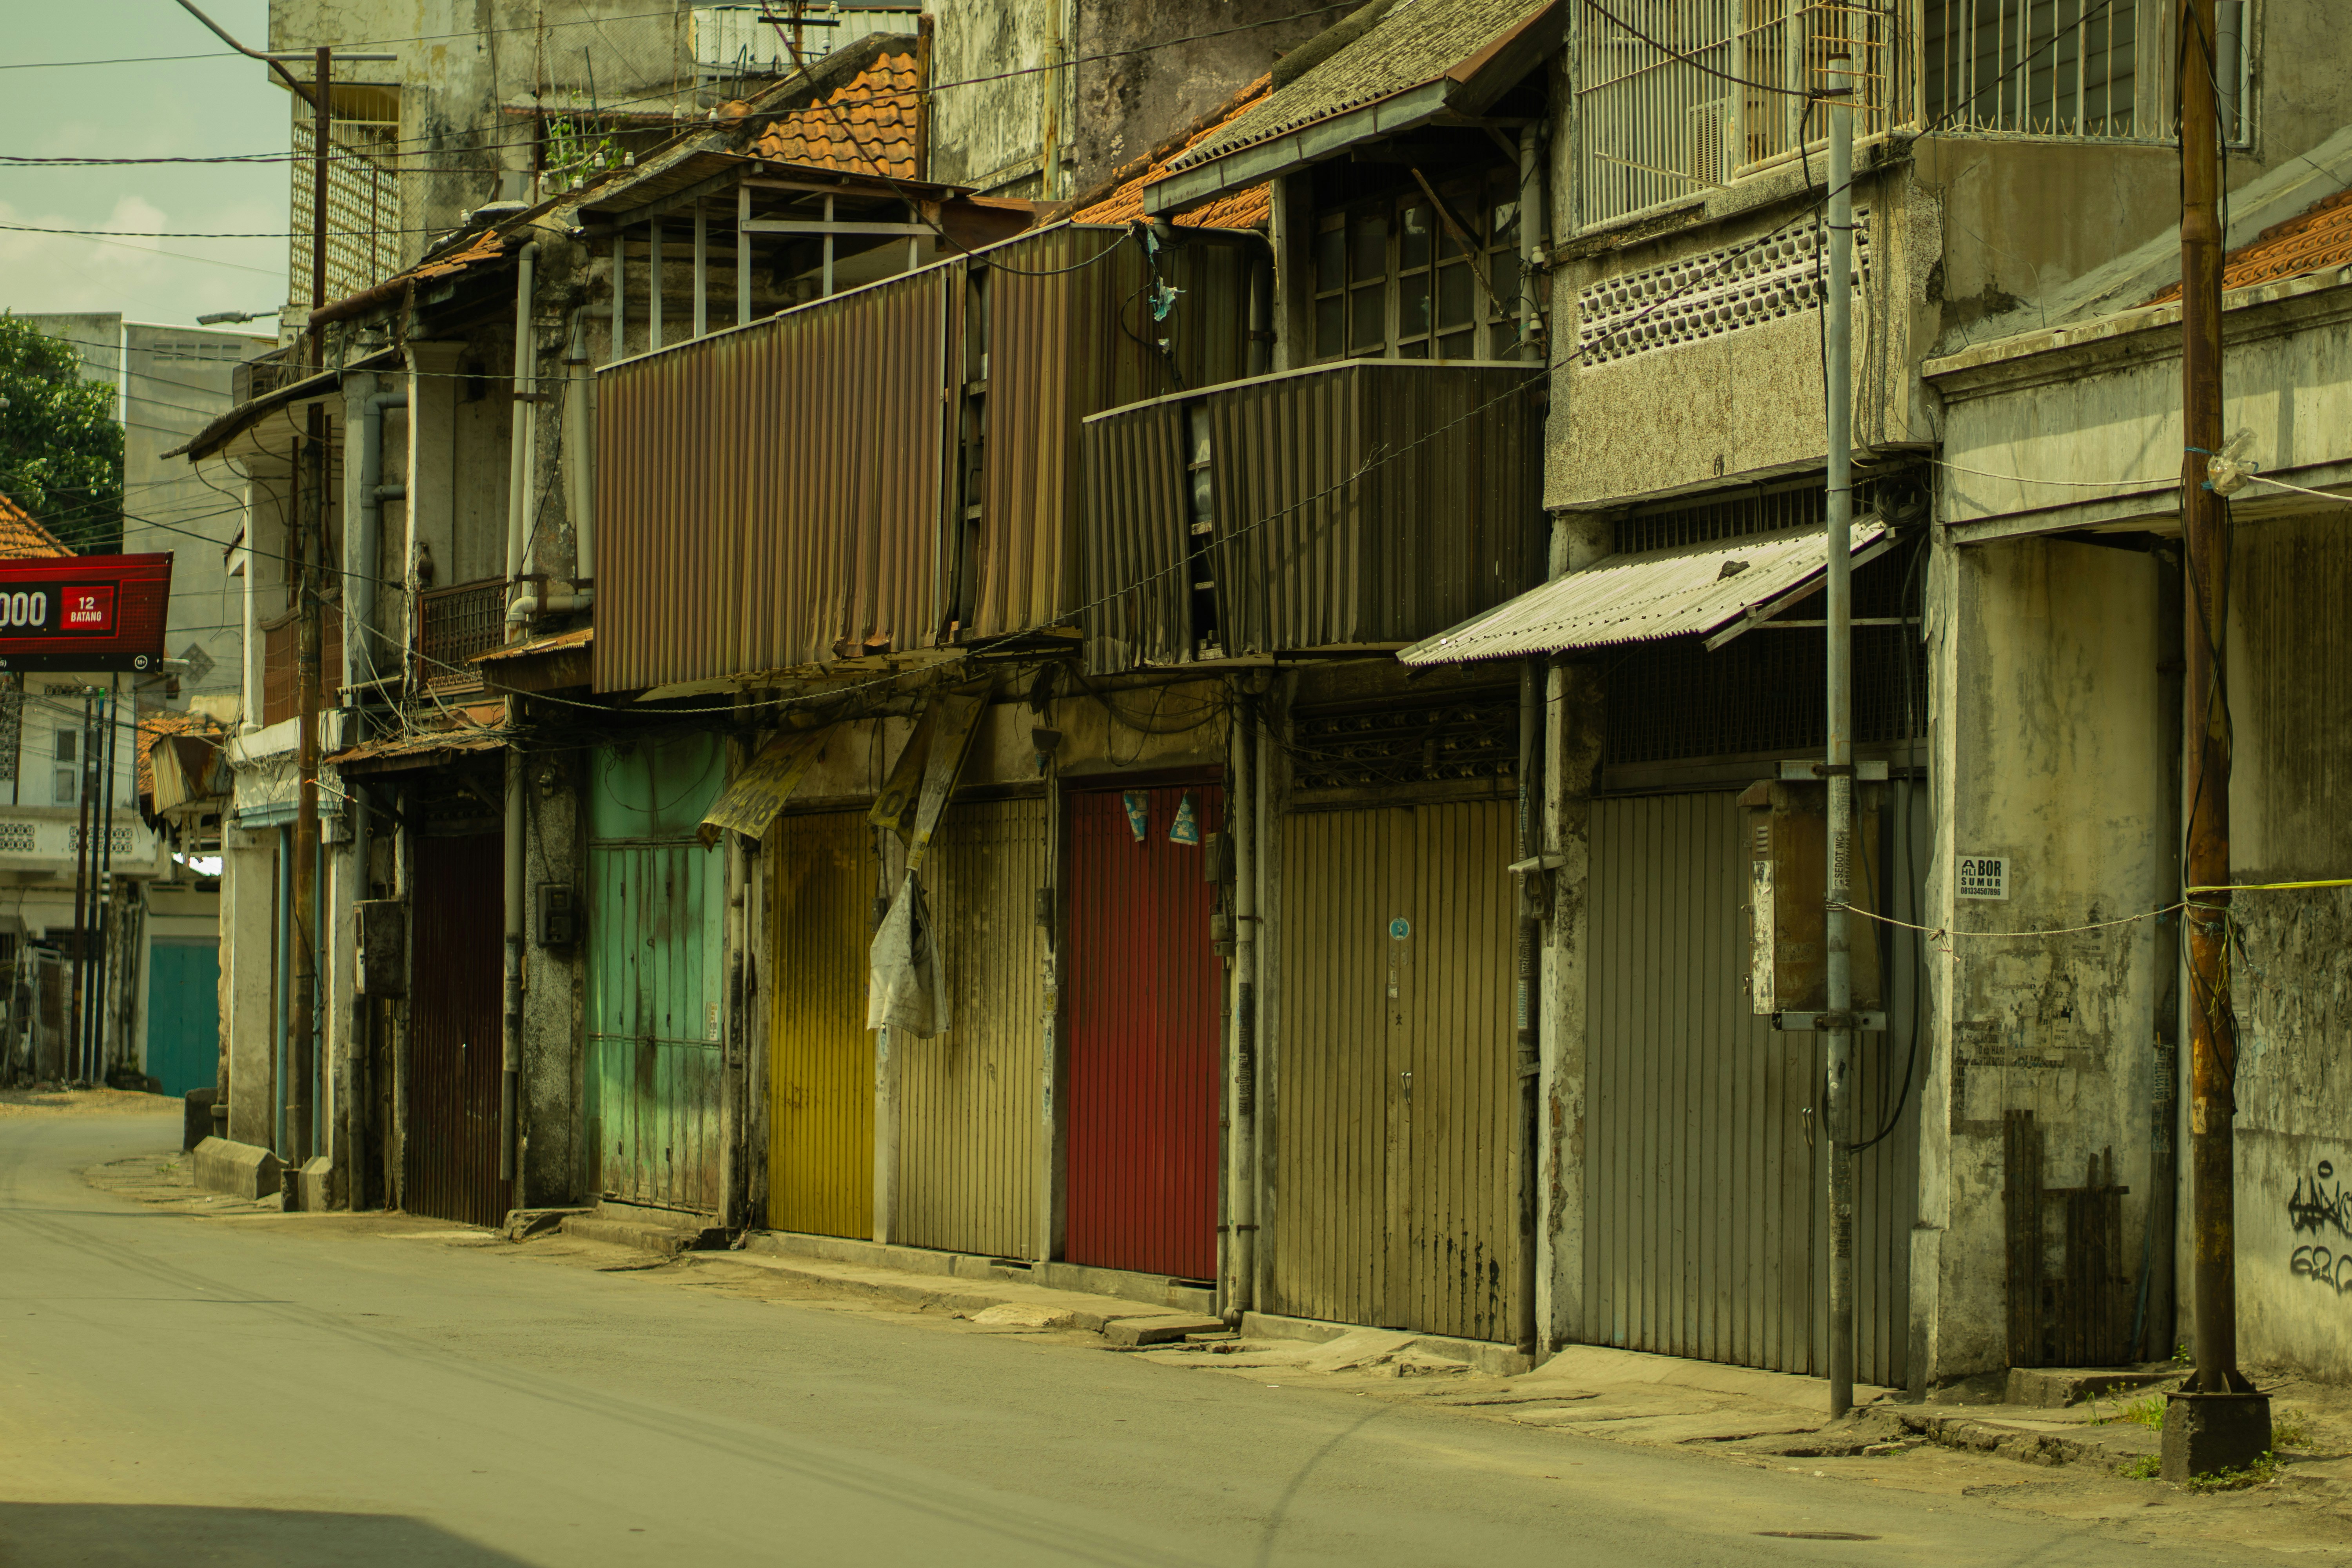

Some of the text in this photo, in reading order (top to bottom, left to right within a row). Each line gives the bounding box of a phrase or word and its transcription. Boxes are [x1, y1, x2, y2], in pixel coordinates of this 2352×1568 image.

[79, 597, 94, 610] 12
[71, 611, 102, 622] BATANG
[1835, 836, 1844, 849] WC
[1835, 851, 1844, 878] SEDOT
[1978, 860, 2002, 877] BOR
[1961, 877, 2001, 887] SUMUR
[1961, 887, 2001, 896] 081334507896
